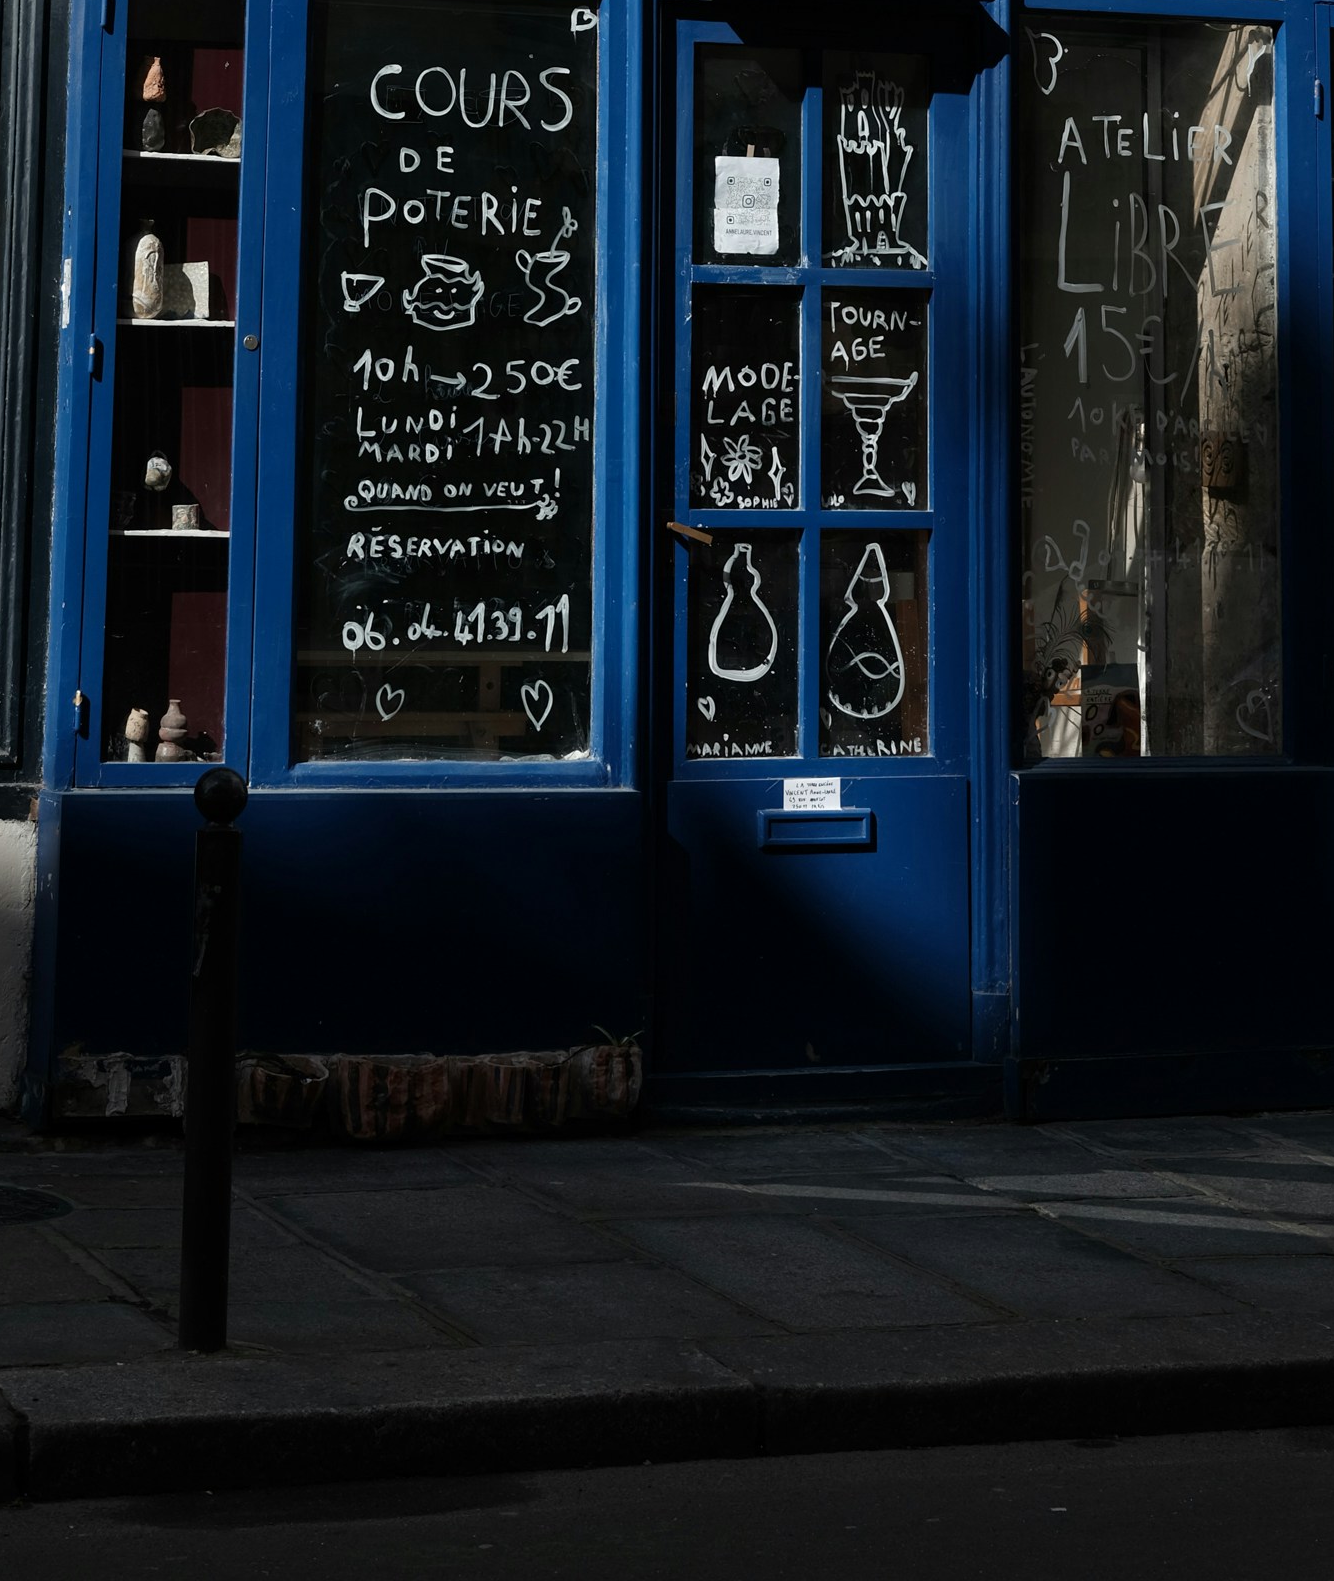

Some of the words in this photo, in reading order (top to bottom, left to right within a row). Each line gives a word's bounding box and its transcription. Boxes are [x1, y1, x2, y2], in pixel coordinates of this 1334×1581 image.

[369, 63, 573, 132] COURS
[399, 146, 455, 174] DE
[830, 335, 886, 367] AGE
[472, 358, 583, 400] 250€
[707, 397, 794, 426] LAGE
[357, 478, 433, 503] QUAND
[443, 483, 473, 498] ON
[737, 495, 779, 509] SOPHIE
